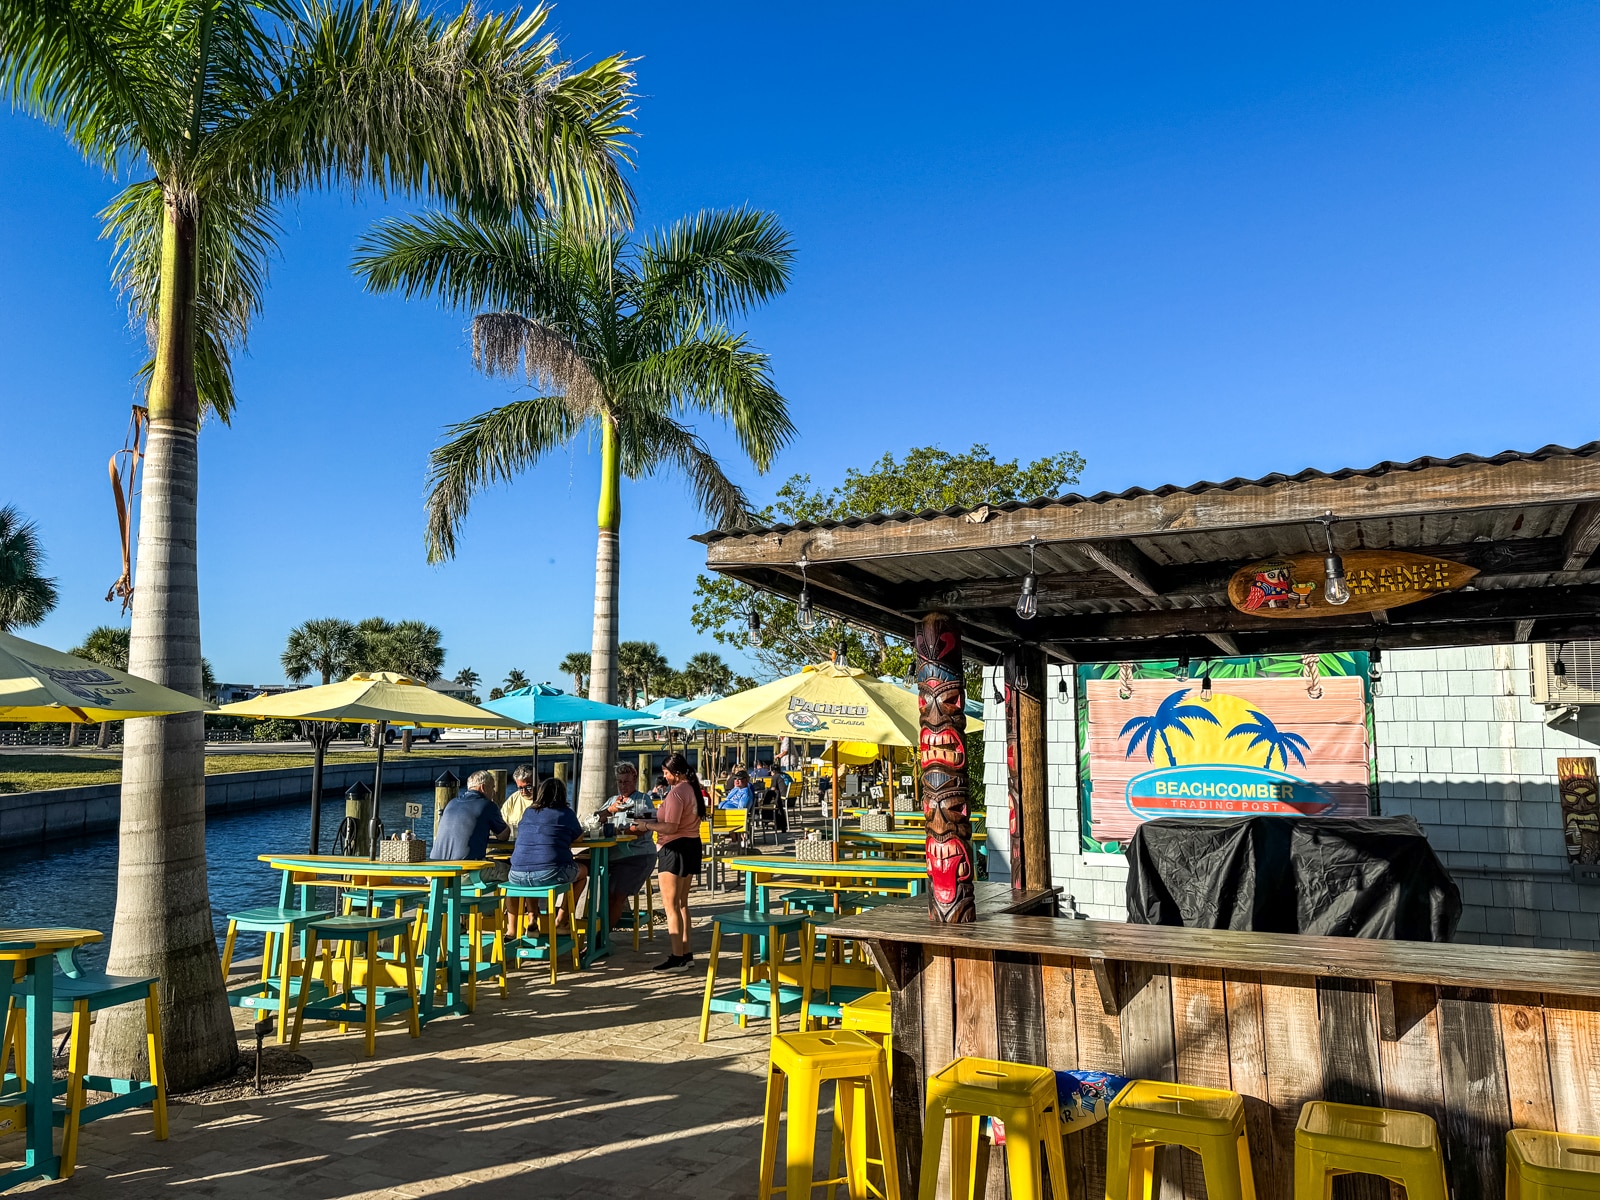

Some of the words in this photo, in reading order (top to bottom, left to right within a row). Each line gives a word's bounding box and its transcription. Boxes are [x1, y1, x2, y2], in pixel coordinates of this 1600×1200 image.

[788, 695, 869, 716] PACIFICO
[831, 718, 865, 726] CLARA
[873, 787, 881, 796] 21
[1155, 781, 1294, 799] BEACHCOMBER
[408, 805, 420, 815] 19
[1170, 799, 1234, 810] TRADING
[1241, 802, 1279, 811] POST
